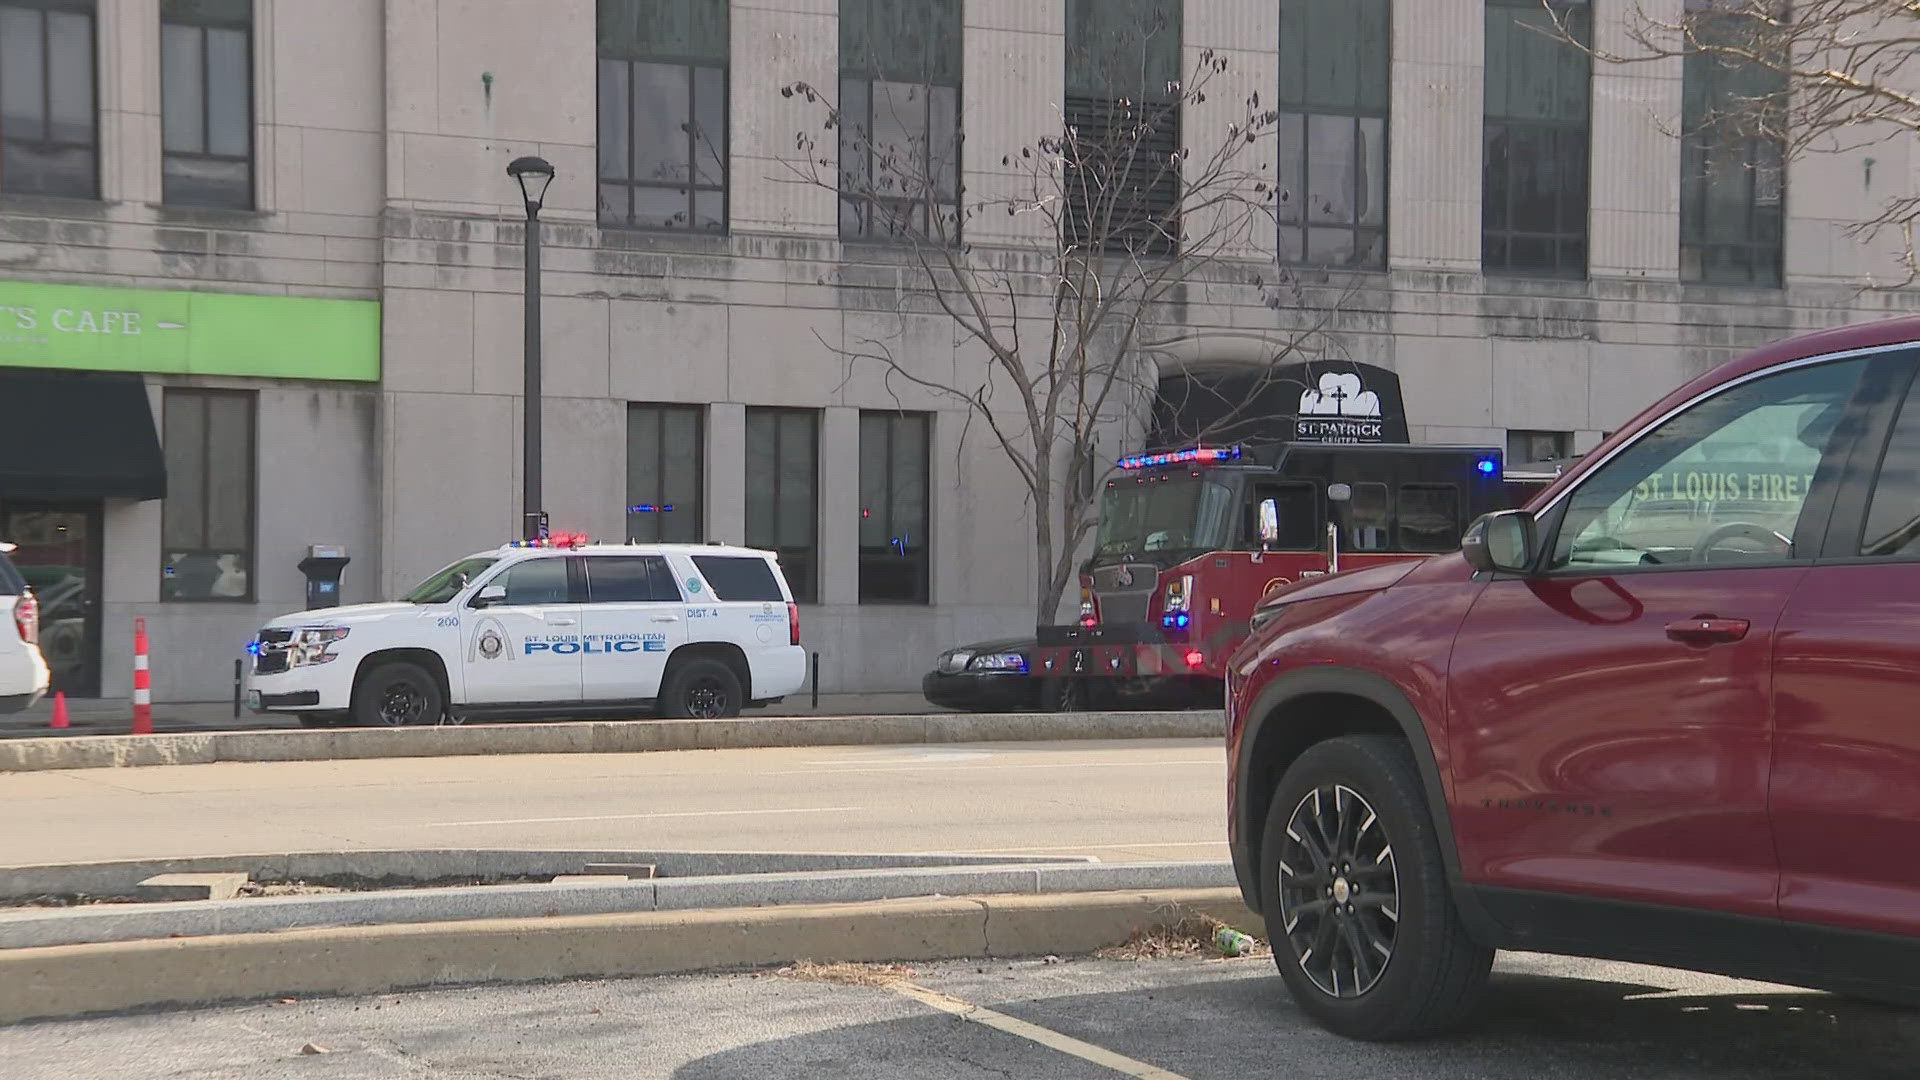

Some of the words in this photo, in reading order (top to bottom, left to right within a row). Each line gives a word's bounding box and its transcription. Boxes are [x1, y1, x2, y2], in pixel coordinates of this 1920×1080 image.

[52, 308, 141, 335] CAFE
[1320, 422, 1382, 436] PATRICK
[1634, 473, 1665, 500] ST.
[1672, 472, 1741, 501] LOUIS
[1747, 474, 1800, 501] FIRE
[687, 609, 709, 618] DIST.
[711, 608, 718, 617] 4
[437, 617, 459, 627] 200
[582, 633, 666, 642] METROPOLITAN
[524, 641, 667, 655] POLICE
